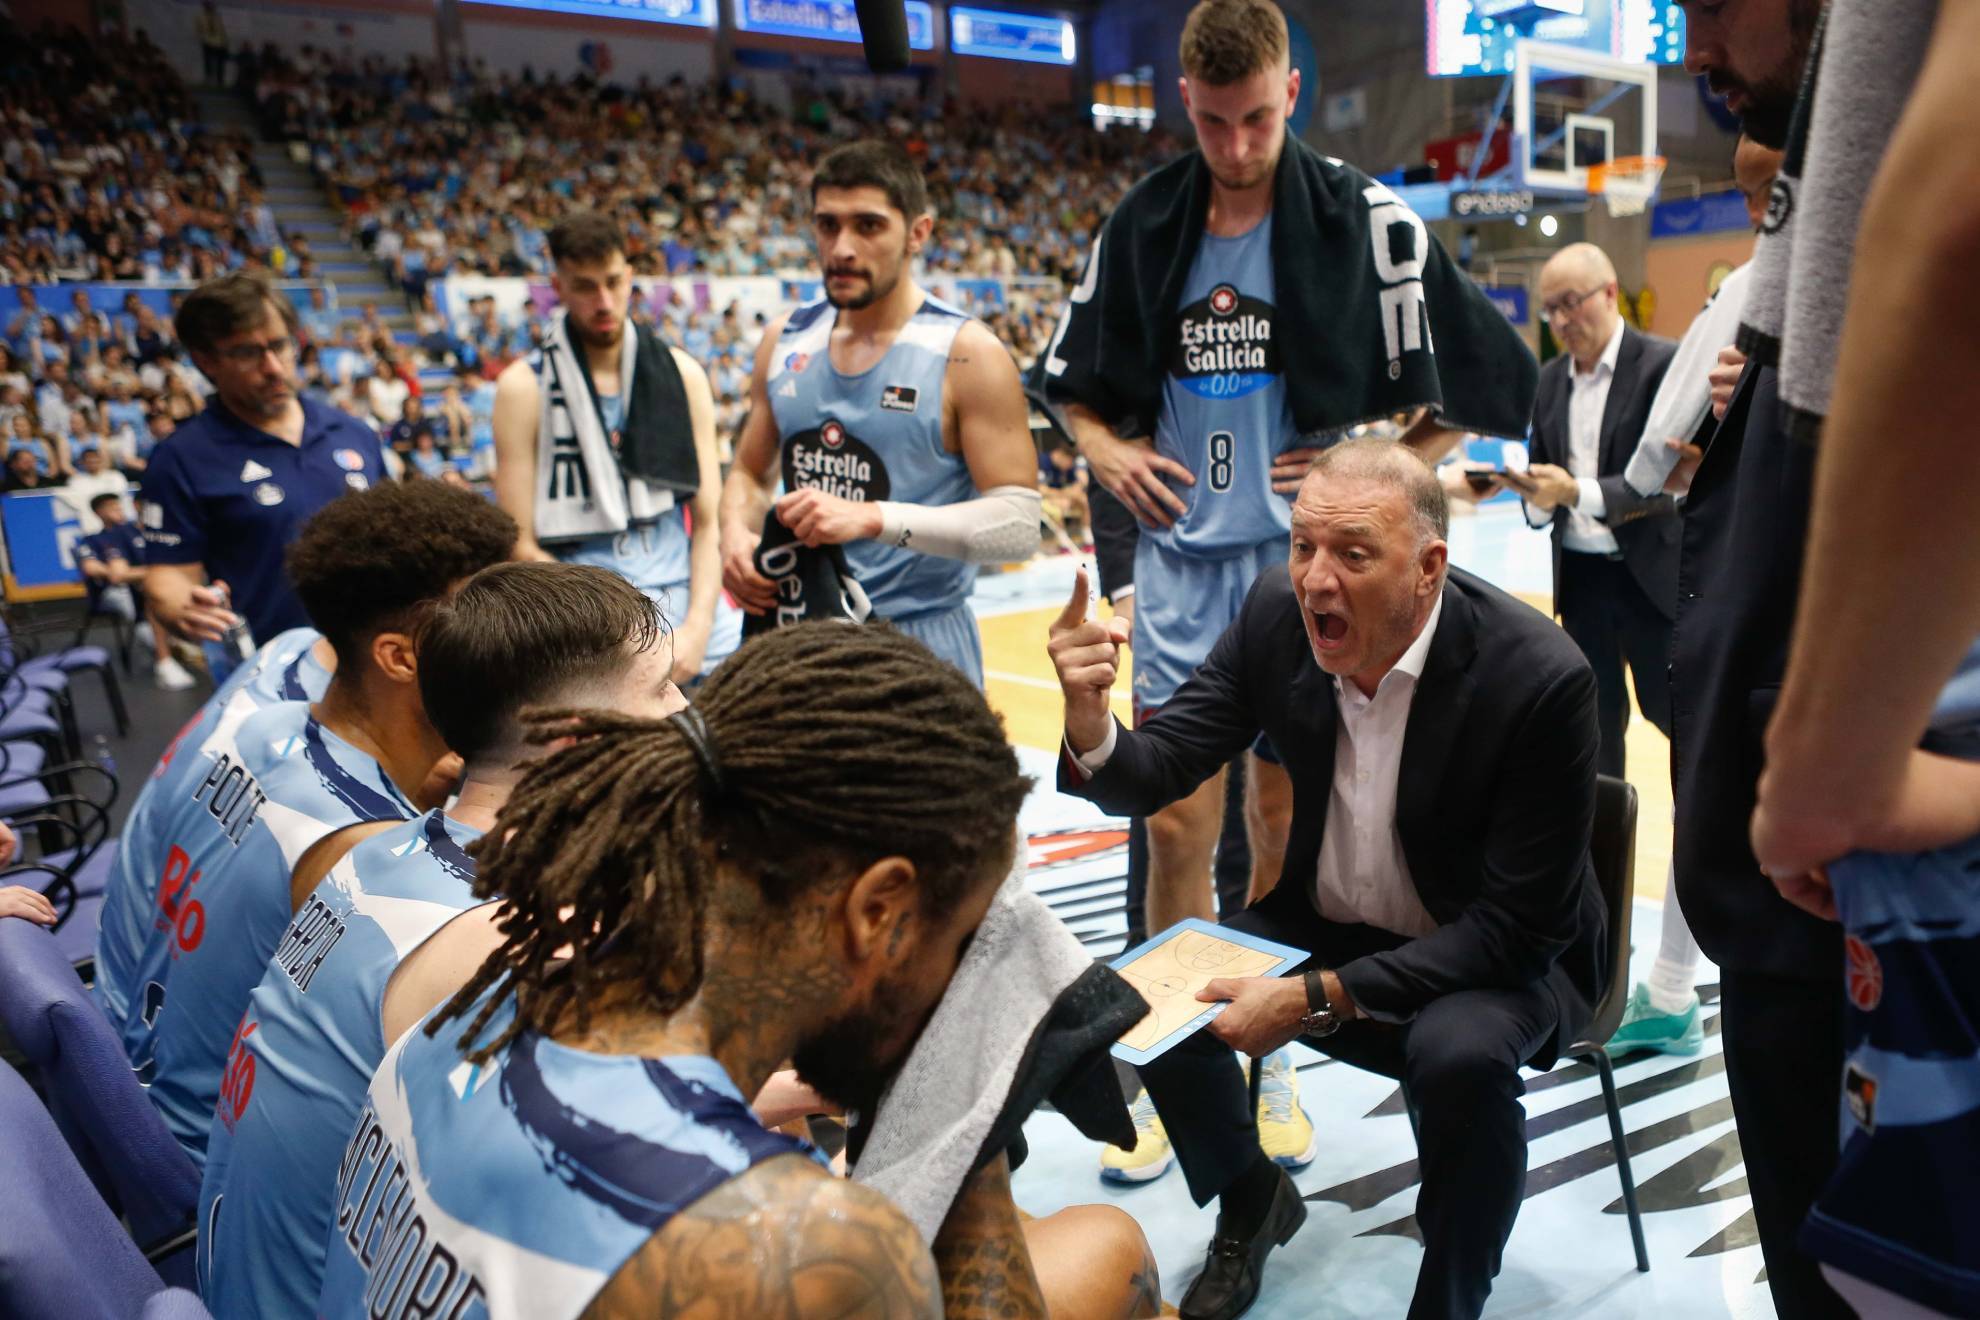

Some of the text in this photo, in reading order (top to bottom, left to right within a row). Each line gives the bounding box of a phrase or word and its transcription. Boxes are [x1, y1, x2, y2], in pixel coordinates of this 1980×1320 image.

[1182, 315, 1270, 345] Estrella
[1186, 342, 1266, 372] Galicia
[1211, 371, 1240, 395] 0,0
[792, 443, 871, 482] Estrella
[1209, 431, 1234, 493] 8
